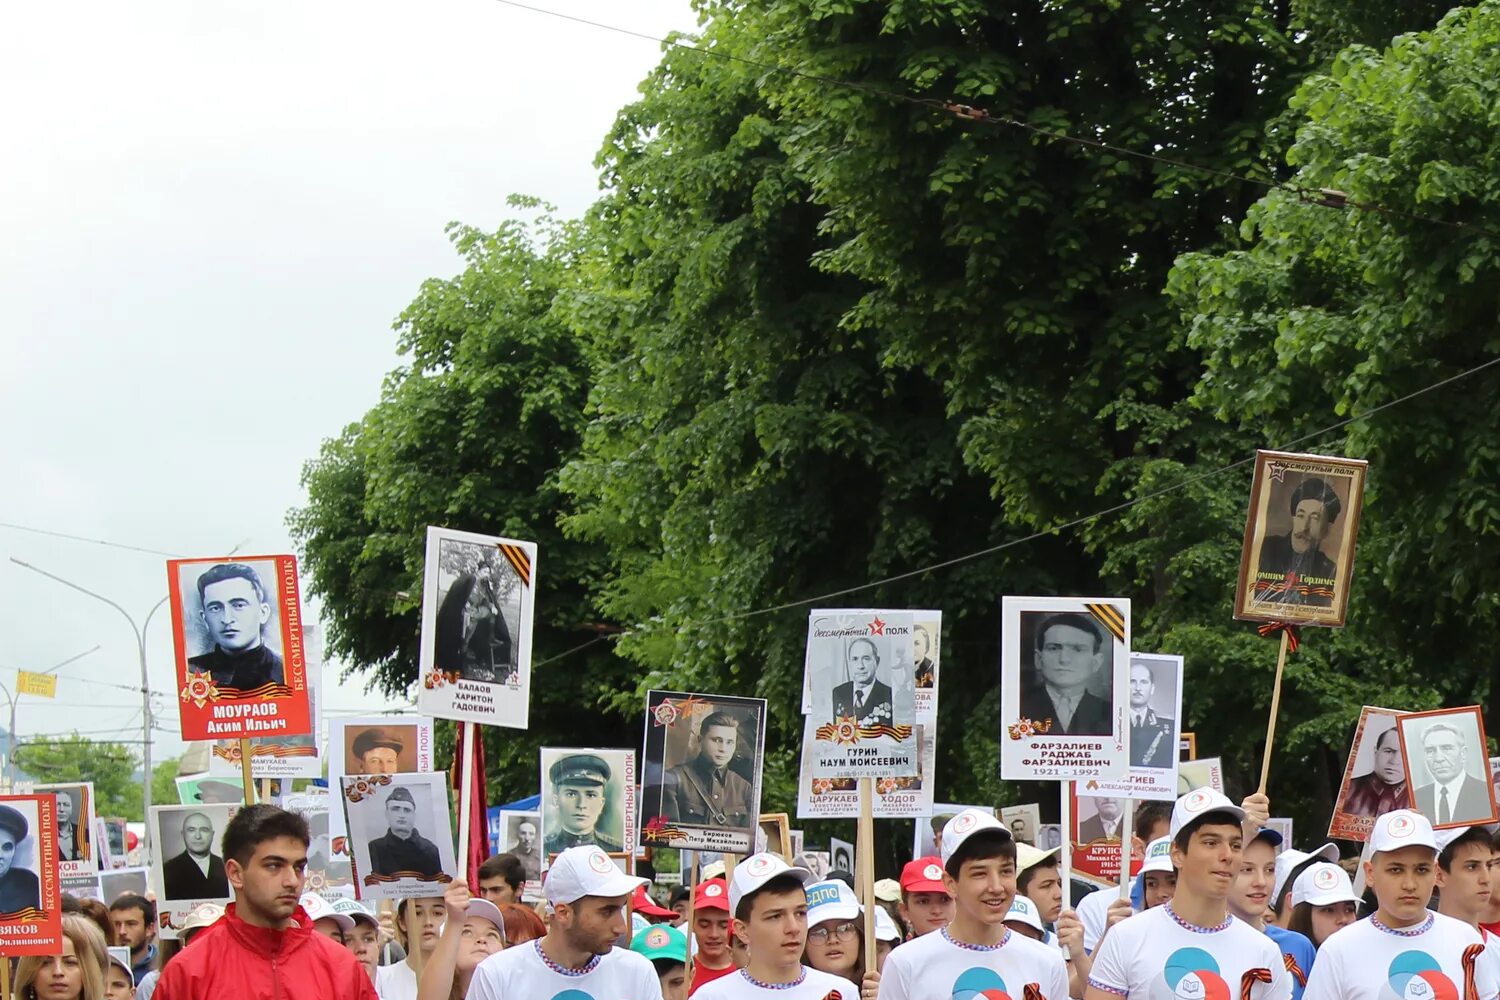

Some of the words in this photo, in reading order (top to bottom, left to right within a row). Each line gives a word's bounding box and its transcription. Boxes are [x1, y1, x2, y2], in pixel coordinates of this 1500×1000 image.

[284, 560, 296, 595] ПОЛК
[1257, 571, 1284, 581] омним
[1299, 574, 1336, 586] Гордимс
[285, 597, 304, 691] БЕССМЕРТНЫЙ
[458, 683, 491, 693] БАЛАОВ
[455, 693, 493, 704] ХАРИТОН
[213, 703, 278, 719] МОУРАОВ
[452, 702, 496, 714] ГАДОЕВИЧ
[207, 721, 242, 734] Аким
[245, 719, 287, 731] Ильич
[420, 726, 429, 751] ПОЛК
[847, 748, 878, 756] ГУРИН
[1030, 742, 1103, 751] ФАРЗАЛИЕВ
[1041, 751, 1092, 760] РАДЖАБ
[625, 752, 634, 780] ПОЛК
[820, 758, 846, 767] НАУМ
[850, 757, 909, 766] МОИСЕЕВИЧ
[1022, 759, 1111, 767] ФАРЗАЛИЕВИЧ
[1211, 766, 1221, 791] ПОЛК
[809, 795, 858, 804] ЦАРУКАЕВ
[881, 795, 916, 803] ХОДОВ
[42, 800, 51, 833] ПОЛК
[625, 782, 634, 852] ССМЕРТНЫЙ
[703, 830, 732, 838] Бирюков
[706, 837, 748, 846] Михайлович
[41, 835, 54, 910] БЕССМЕРТНЫЙ
